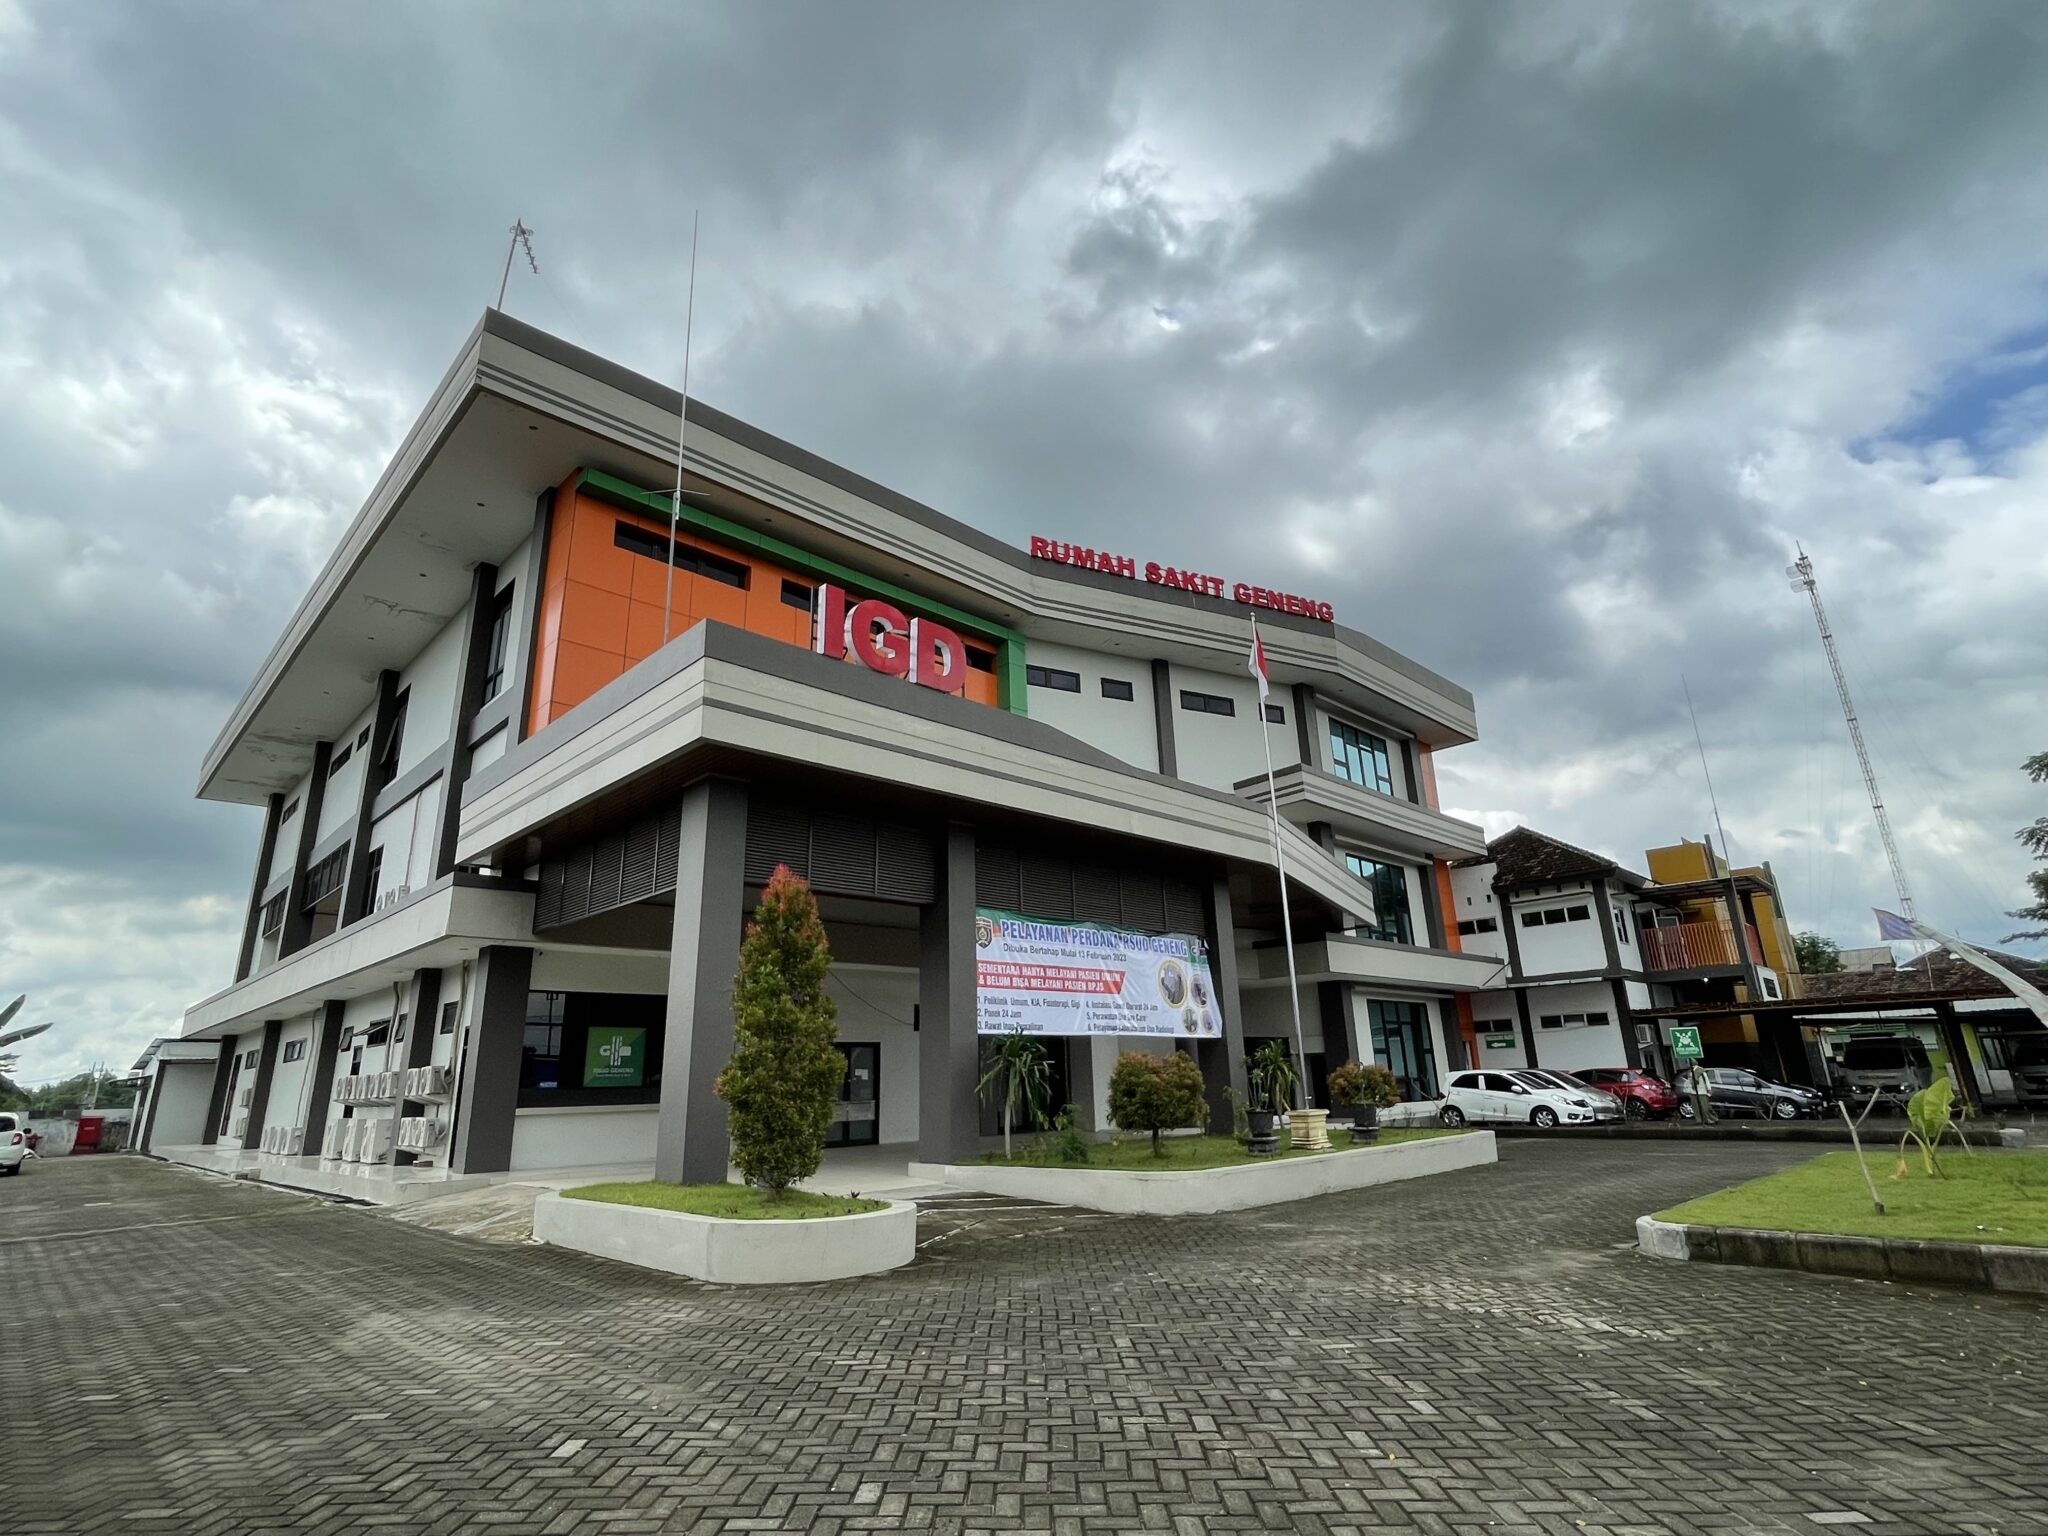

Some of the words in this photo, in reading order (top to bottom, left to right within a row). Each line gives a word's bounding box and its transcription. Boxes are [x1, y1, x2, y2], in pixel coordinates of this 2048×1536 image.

[1031, 536, 1135, 579] RUMAH
[1145, 562, 1224, 598] SAKIT
[1233, 583, 1334, 622] GENENG
[817, 583, 967, 692] IGD
[1002, 920, 1068, 943] PELAYANAN
[1071, 927, 1120, 948] PERDANA
[1123, 934, 1149, 951] RSUD
[1152, 937, 1187, 955] GENENG
[1003, 943, 1028, 953] Dibuka
[1029, 945, 1059, 957] Bertahap
[1060, 948, 1076, 957] Mulai
[1078, 950, 1085, 958] 13
[1112, 952, 1127, 962] 2023
[978, 963, 1020, 975] SEMENTARA
[1022, 966, 1044, 976] HANYA
[1046, 968, 1077, 979] MELAYANI
[1078, 970, 1100, 980] PASIEN
[1101, 971, 1121, 981] UMUM
[986, 976, 1011, 986] BELUM
[1012, 977, 1029, 987] BISA
[1030, 979, 1063, 989] MELAYANI
[1064, 981, 1086, 990] PASIEN
[1087, 982, 1105, 991] BPJS
